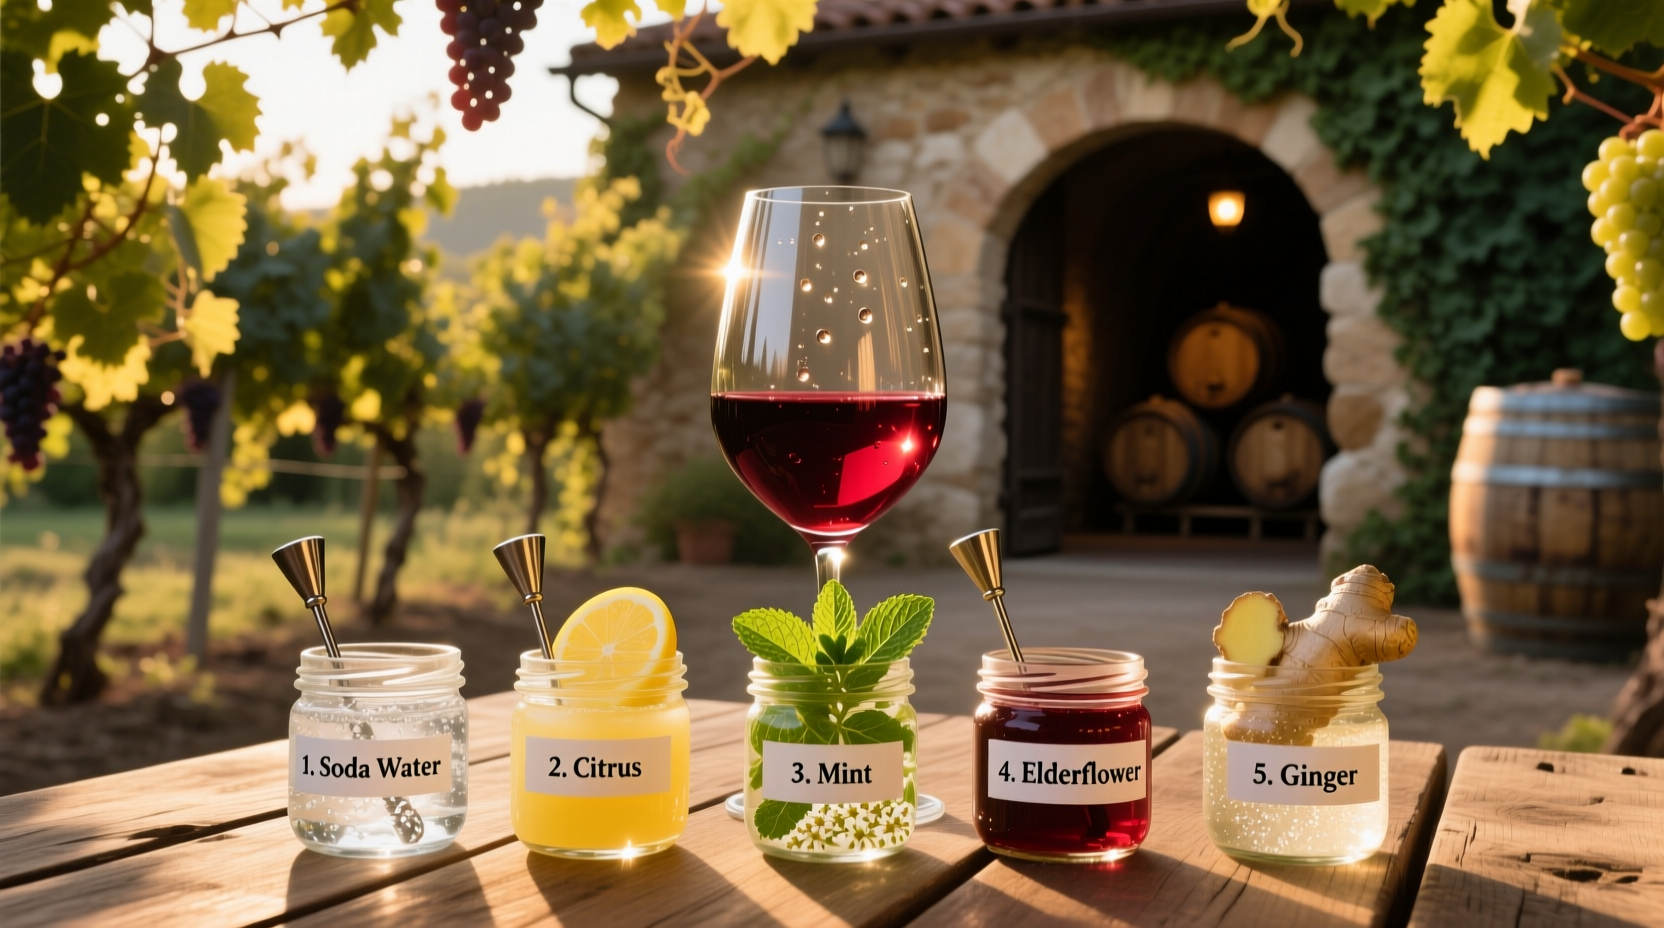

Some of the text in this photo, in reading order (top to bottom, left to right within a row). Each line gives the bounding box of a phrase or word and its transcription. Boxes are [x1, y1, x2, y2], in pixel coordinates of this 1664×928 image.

[302, 754, 442, 779] 1. Soda Water
[548, 756, 642, 779] 2. Citrus
[791, 761, 873, 785] 3. Mint
[998, 760, 1142, 786] 4. Elderflower
[1252, 762, 1359, 794] 5. Ginger
